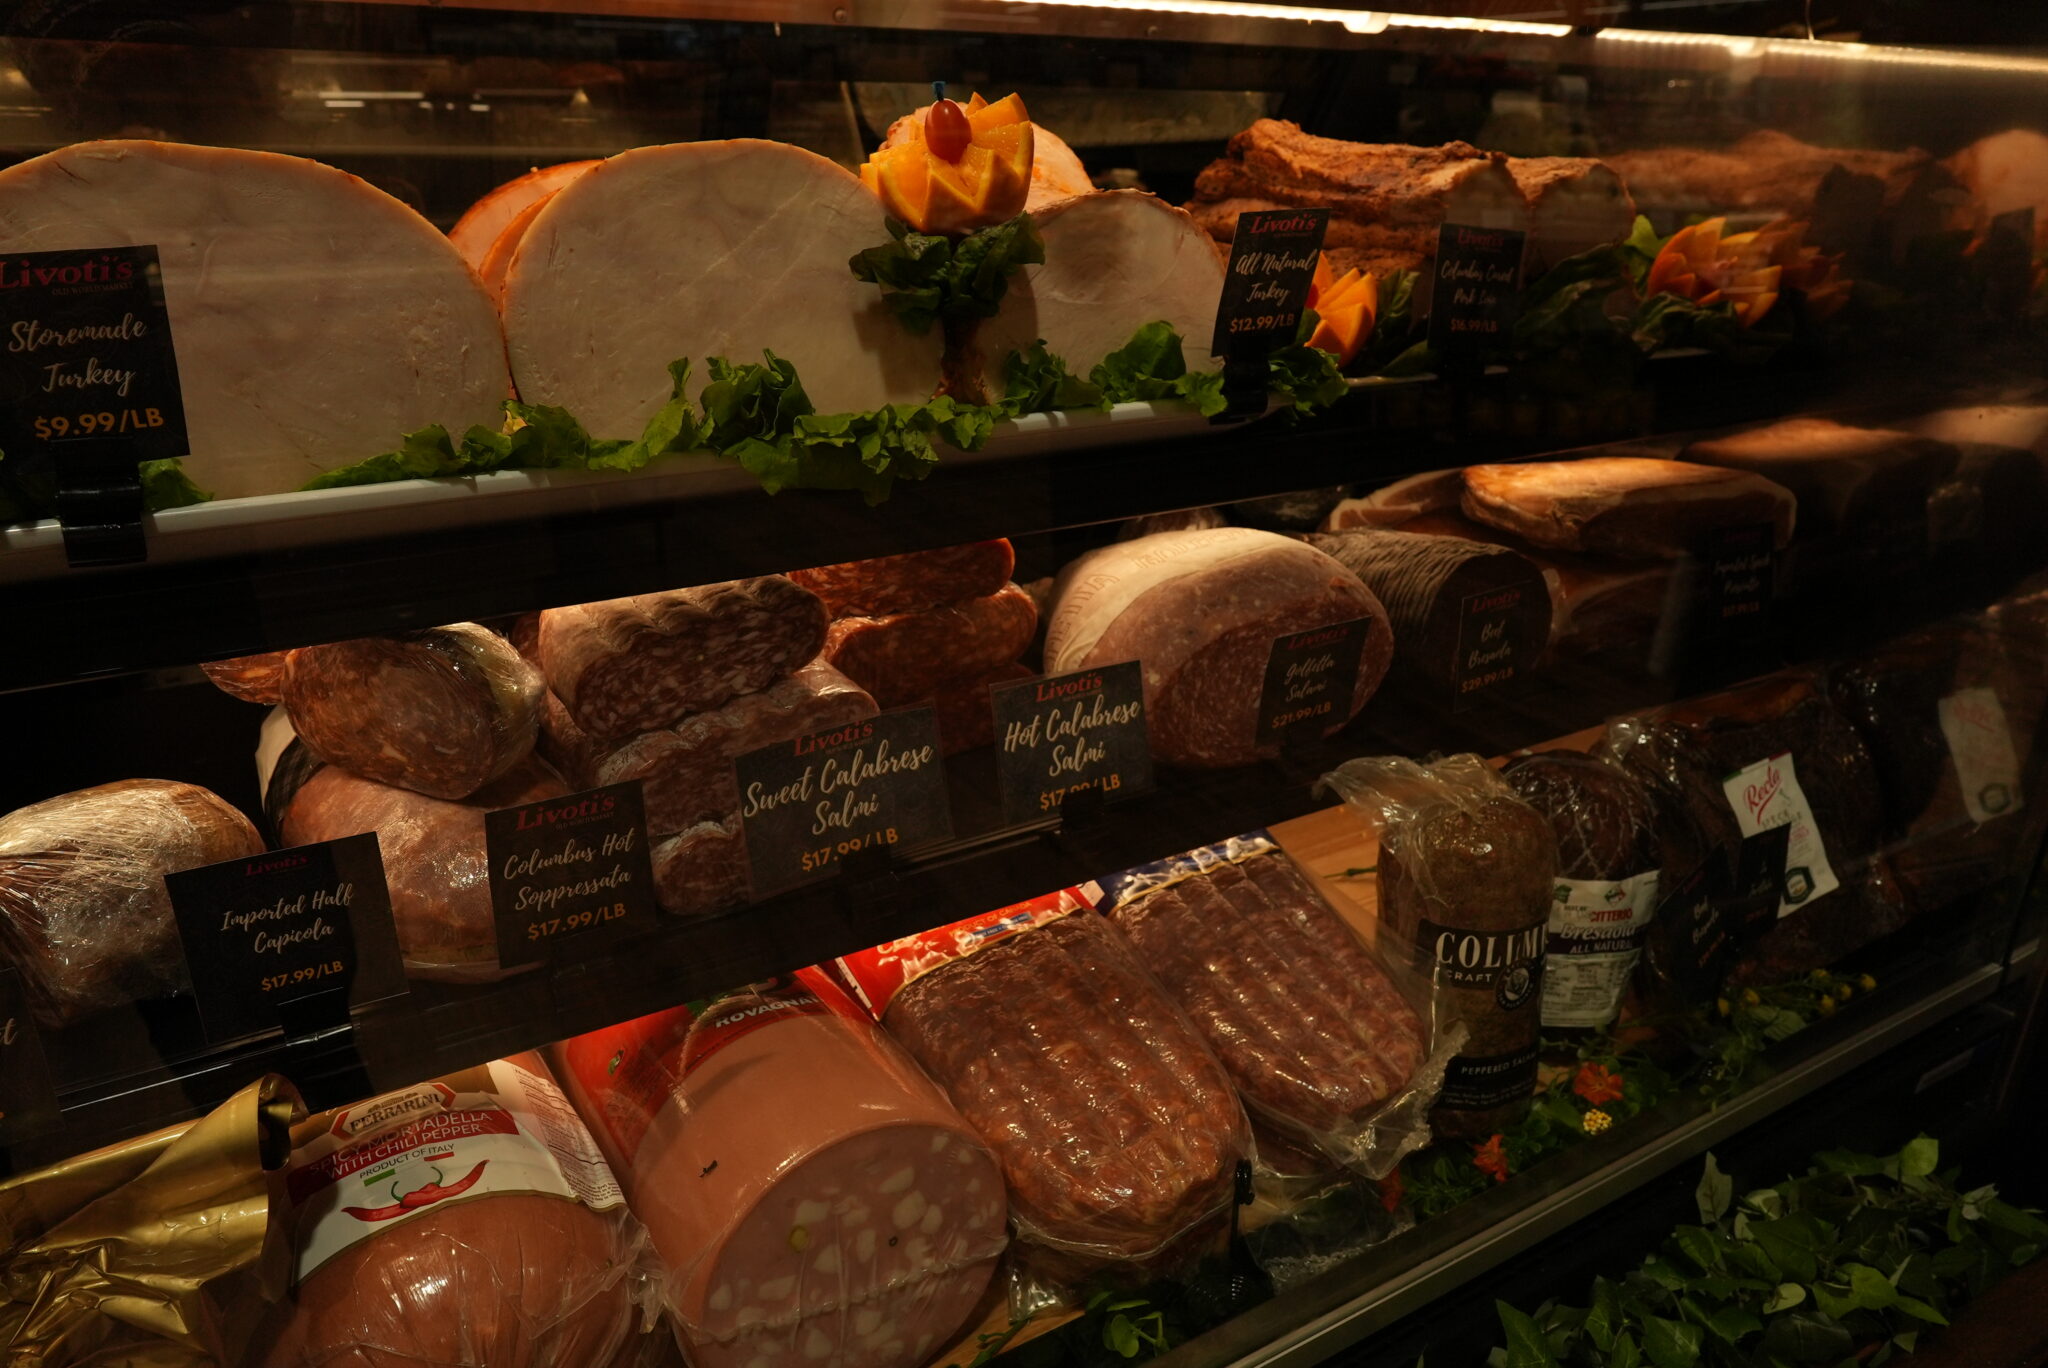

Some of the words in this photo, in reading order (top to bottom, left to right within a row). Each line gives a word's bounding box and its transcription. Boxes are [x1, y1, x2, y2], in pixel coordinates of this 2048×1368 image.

[1249, 213, 1317, 234] Livoti's
[0, 255, 134, 289] Livoti's
[1235, 251, 1262, 275] All
[1261, 248, 1318, 275] Natural
[1245, 280, 1291, 307] Turkey
[8, 312, 148, 352] Storemade
[1229, 313, 1296, 334] $12.99/LB
[41, 356, 136, 397] Turkey
[33, 407, 165, 441] $9.99/LB
[1035, 672, 1104, 703] Livoti's
[793, 720, 874, 757] Livoti's
[1003, 714, 1042, 753] Hot
[1045, 694, 1141, 742] Calabrese
[1048, 736, 1106, 777] Salmi
[743, 765, 814, 818] Sweet
[819, 739, 933, 794] Calabrese
[515, 793, 617, 832] Livoti's
[811, 790, 880, 836] Salmi
[245, 853, 310, 878] Livoti's
[503, 838, 597, 880] Columbus
[601, 827, 636, 857] Hot
[220, 893, 307, 932] Imported
[311, 880, 354, 911] Half
[514, 863, 632, 913] Soppressata
[253, 916, 335, 955] Capicola
[527, 902, 627, 942] $17.99/LB
[1569, 944, 1591, 955] ALL
[260, 959, 345, 992] $17.99/LB
[350, 1092, 441, 1132] FERRARINI
[309, 1143, 362, 1176] SPICY
[367, 1111, 493, 1151] MORTADELLA
[327, 1152, 372, 1180] WITH
[374, 1135, 419, 1159] CHILI
[422, 1123, 483, 1143] PEPPER
[359, 1153, 410, 1179] PRODUCT
[412, 1149, 427, 1159] OF
[428, 1143, 455, 1155] ITALY
